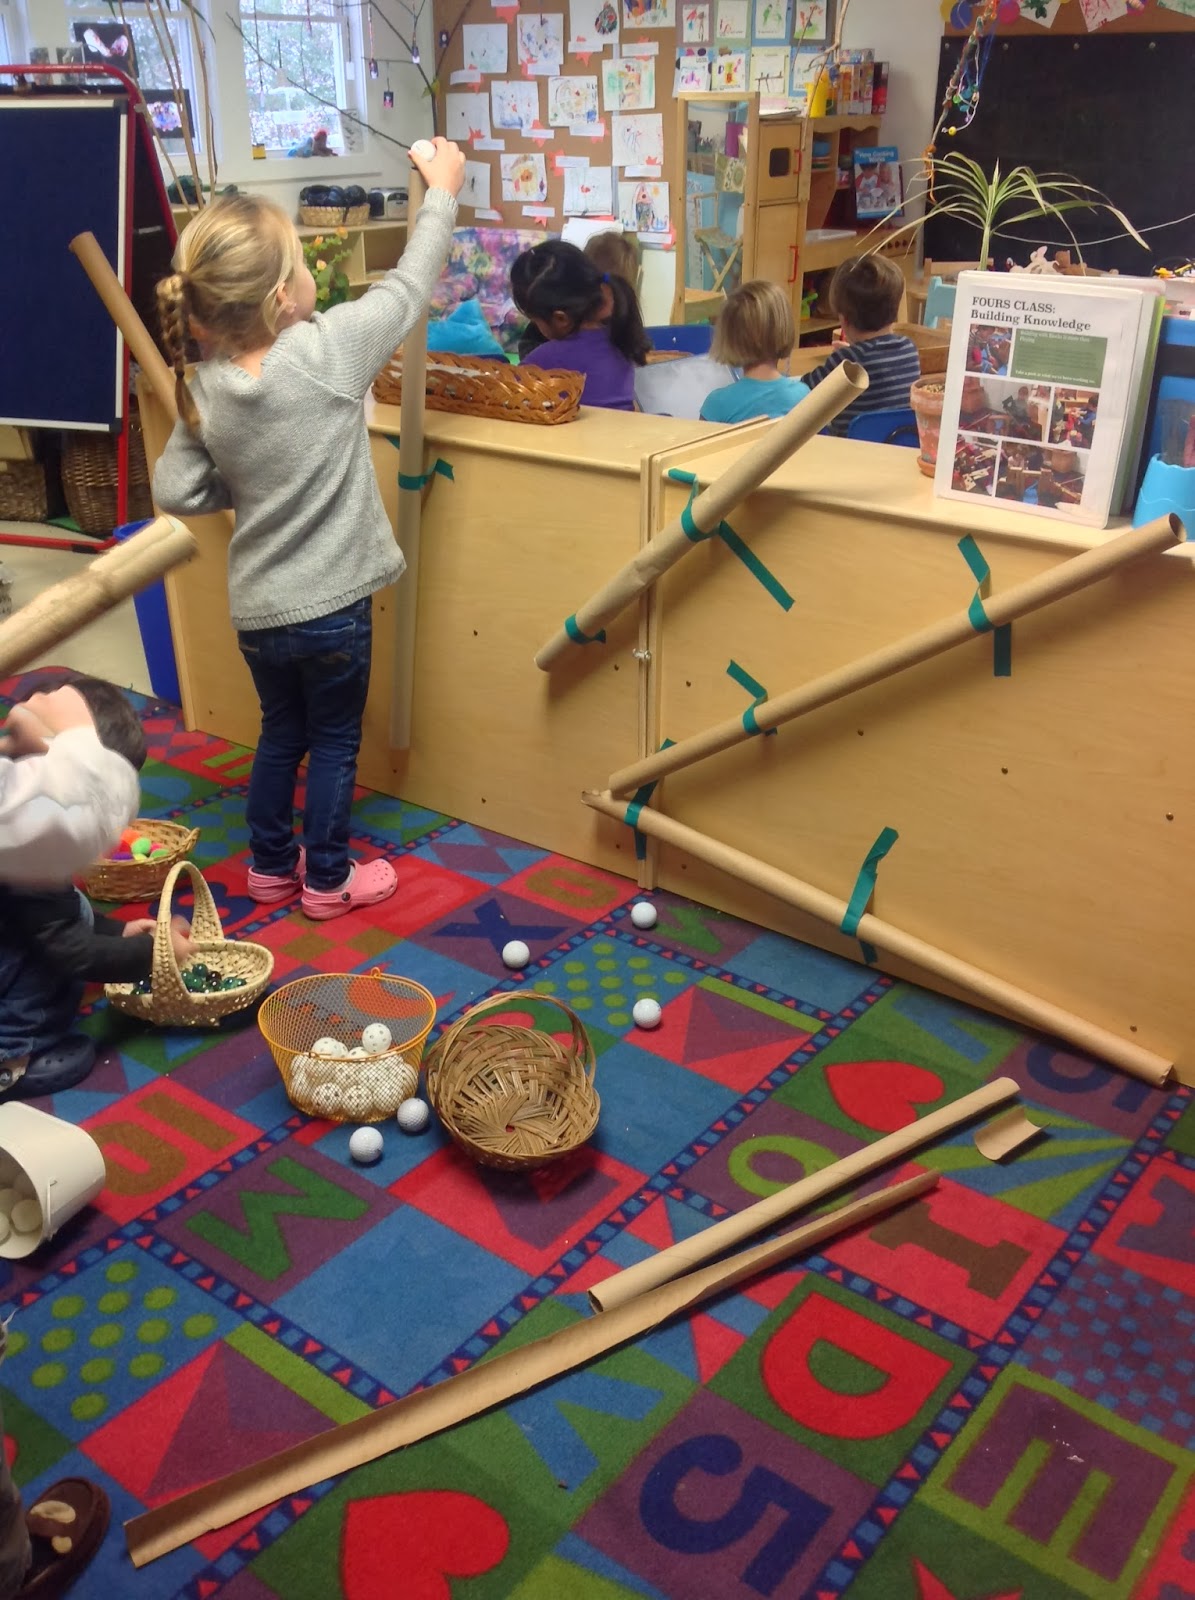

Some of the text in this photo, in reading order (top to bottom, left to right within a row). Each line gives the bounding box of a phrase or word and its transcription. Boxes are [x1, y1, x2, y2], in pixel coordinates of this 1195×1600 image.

[970, 309, 1092, 332] Building Knowledge
[971, 296, 1056, 314] FOURS CLASS:
[759, 1291, 953, 1440] D
[639, 1433, 834, 1598] 5
